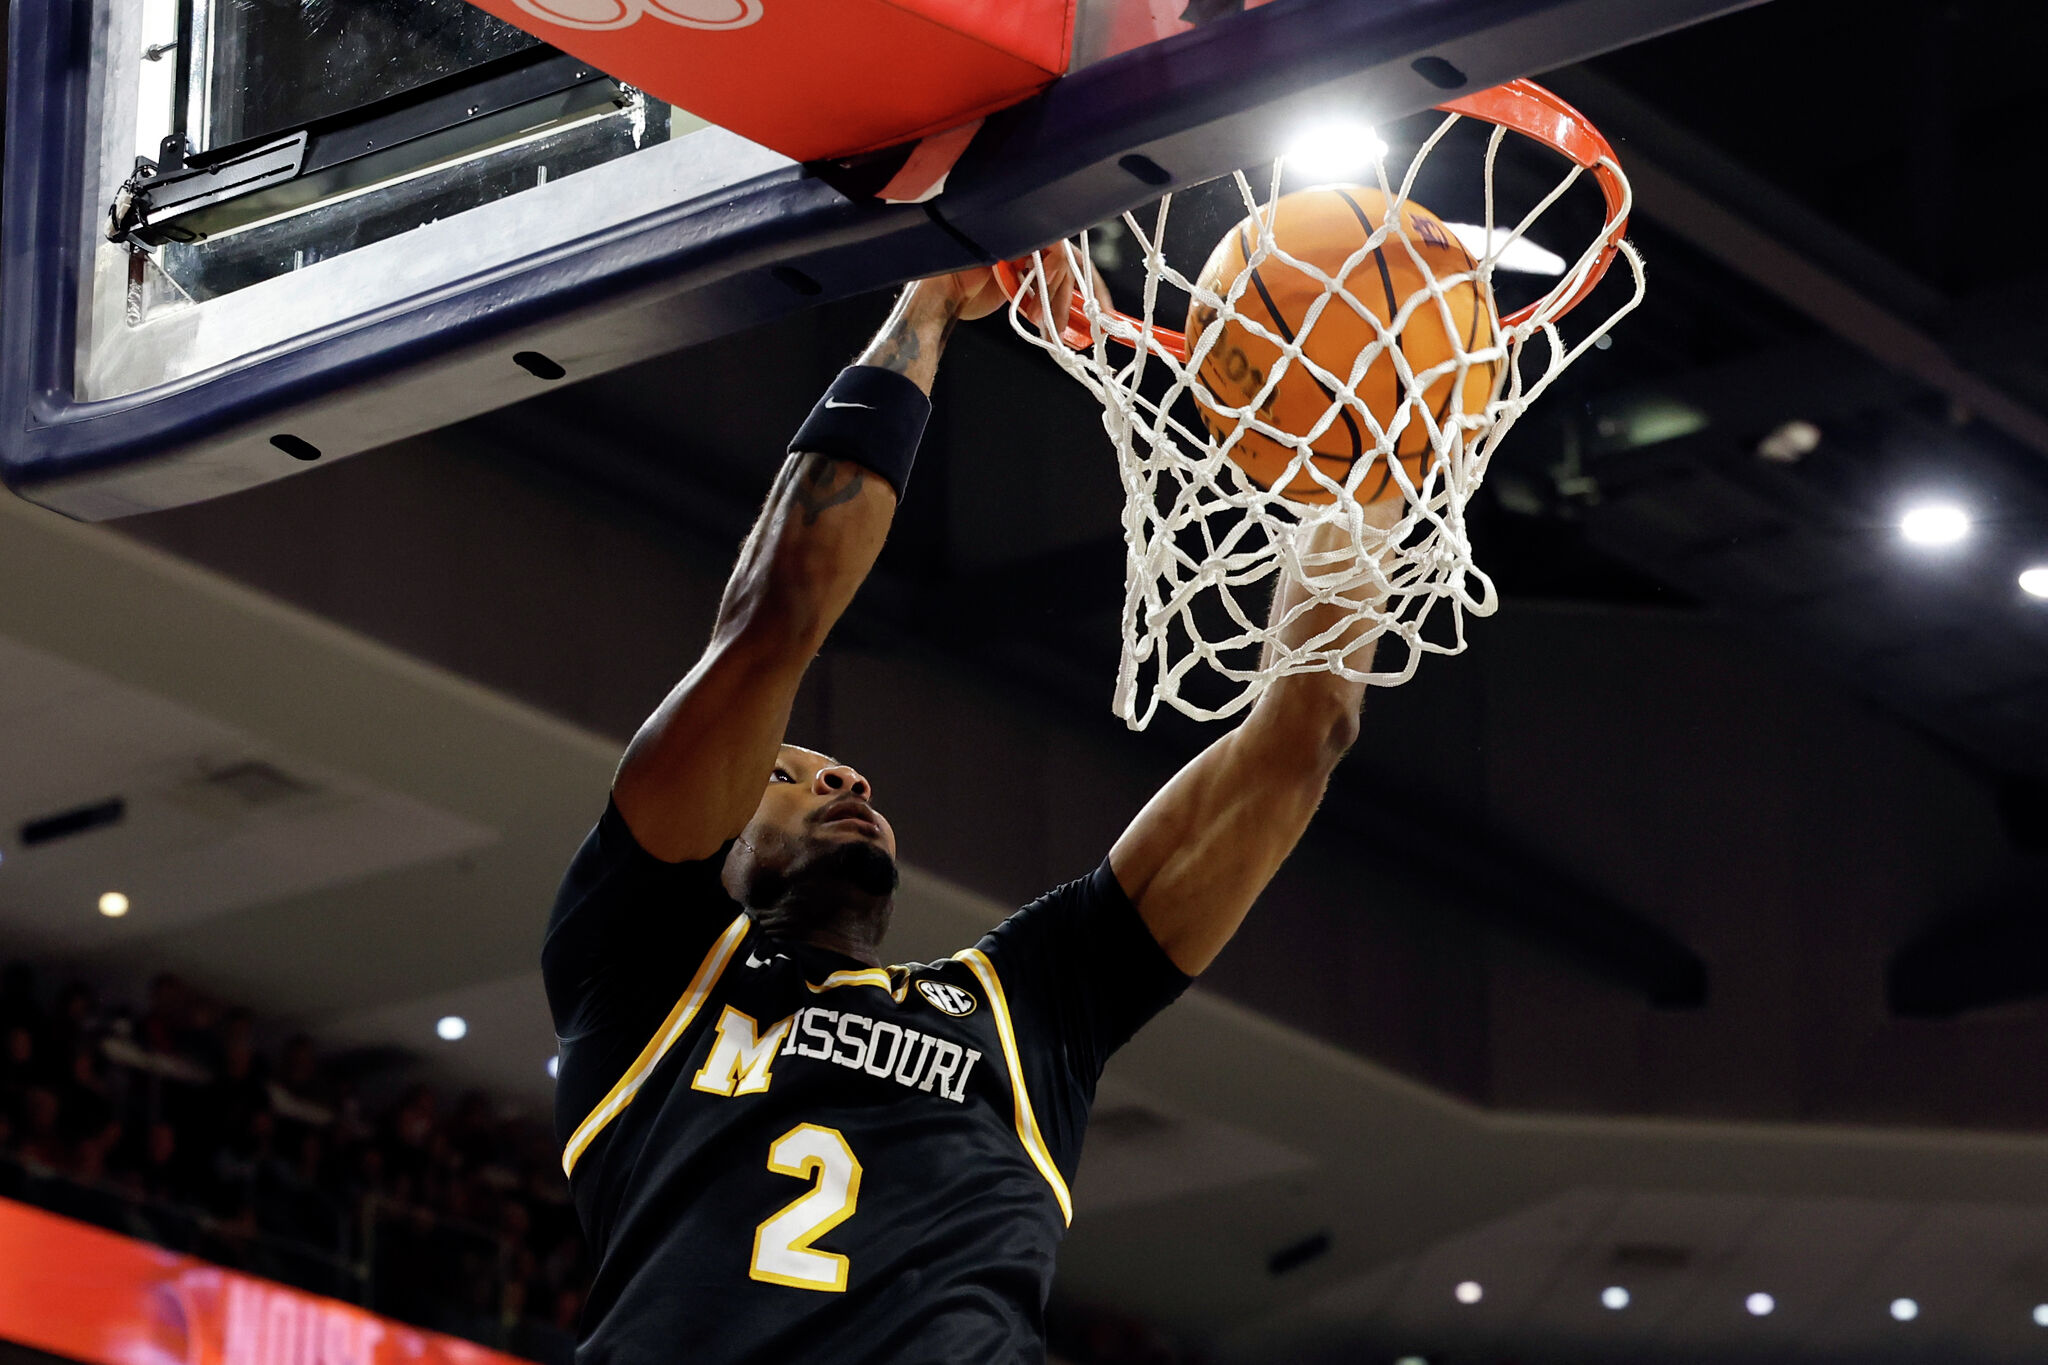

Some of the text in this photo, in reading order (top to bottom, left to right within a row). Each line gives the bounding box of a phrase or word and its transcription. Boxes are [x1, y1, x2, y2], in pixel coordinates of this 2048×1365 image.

[920, 982, 972, 1013] SEC
[691, 1004, 981, 1103] MISSOURI
[749, 1122, 863, 1293] 2
